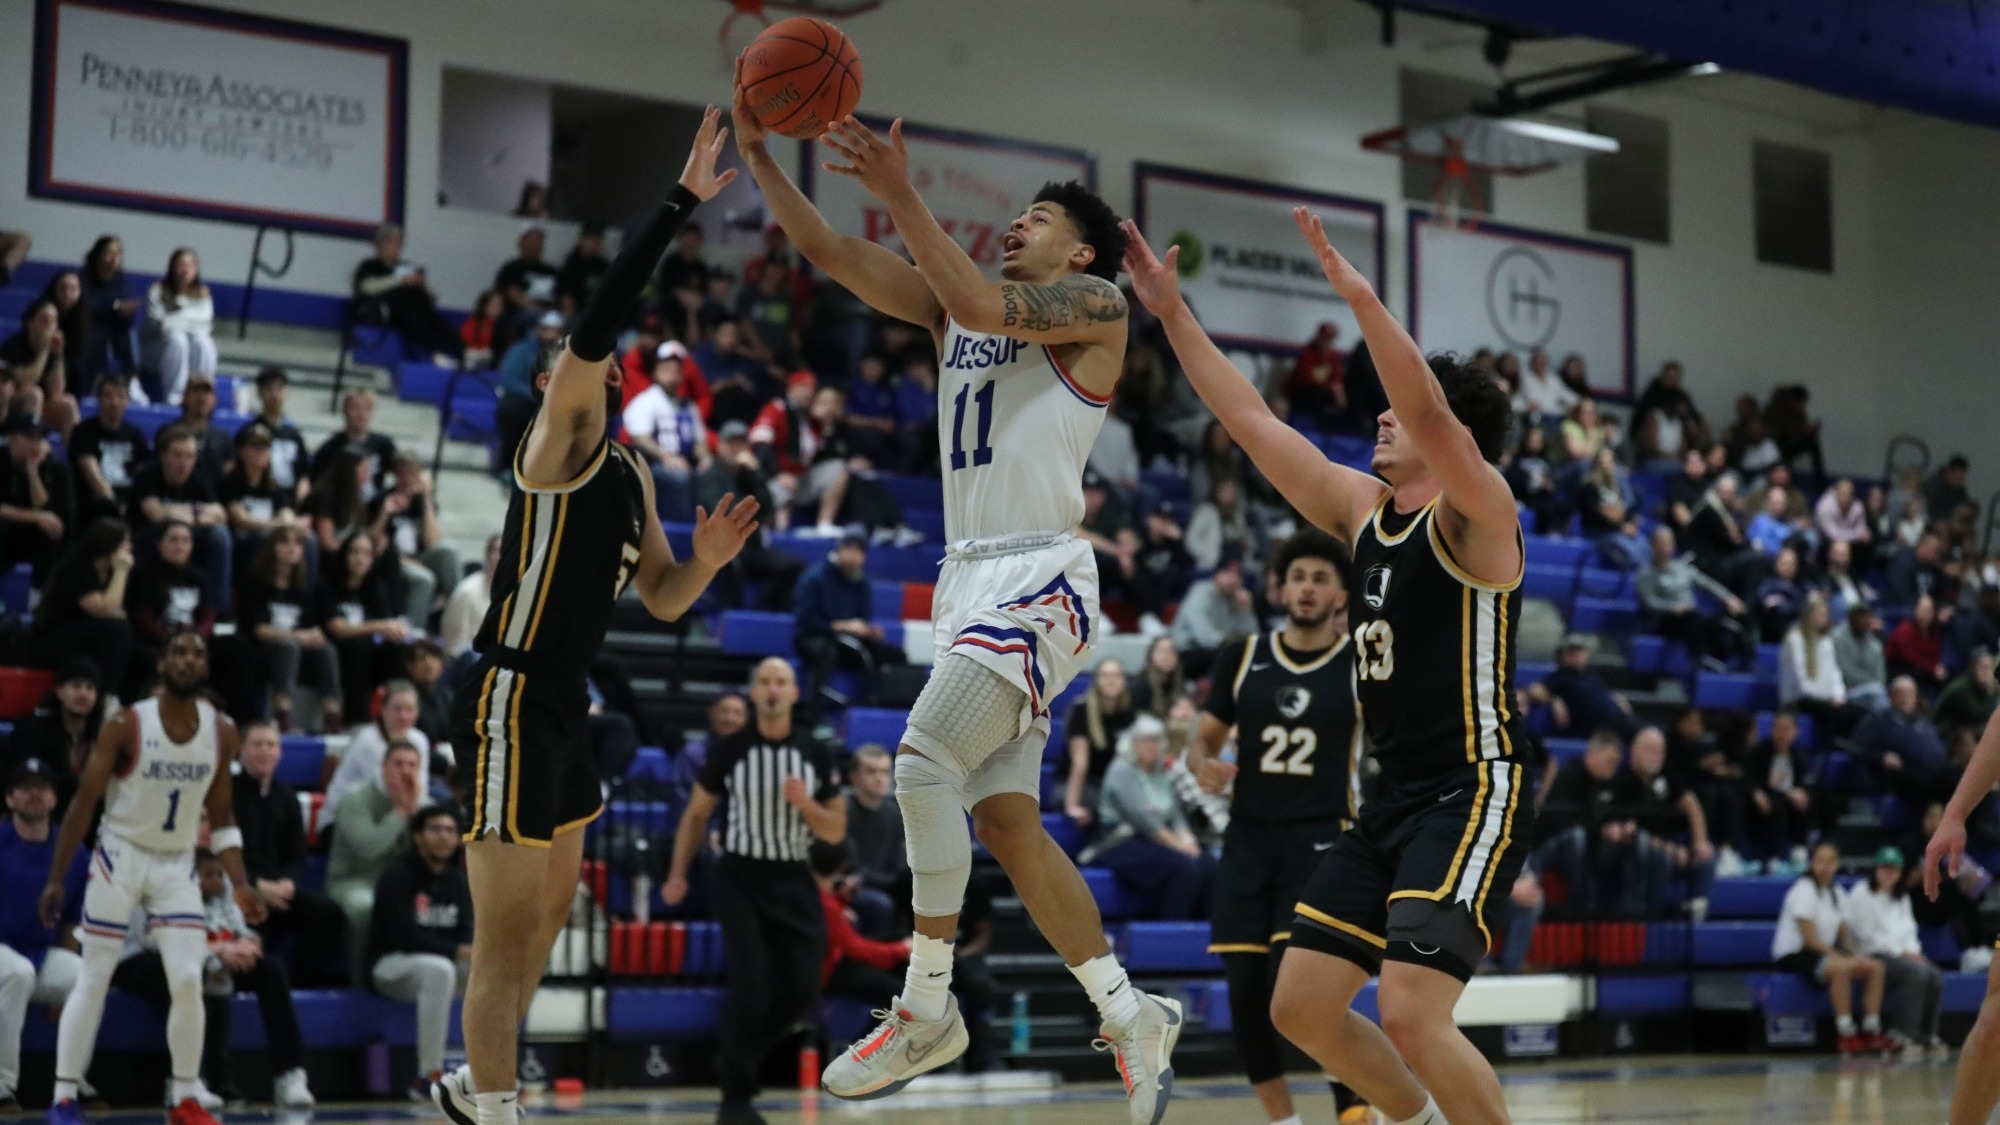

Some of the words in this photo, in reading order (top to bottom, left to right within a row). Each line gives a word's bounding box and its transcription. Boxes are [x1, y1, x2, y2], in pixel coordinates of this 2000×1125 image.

[950, 380, 995, 471] 11
[1355, 620, 1394, 681] 13
[142, 761, 210, 781] JESSUP
[1261, 725, 1317, 776] 22
[162, 788, 180, 831] 1
